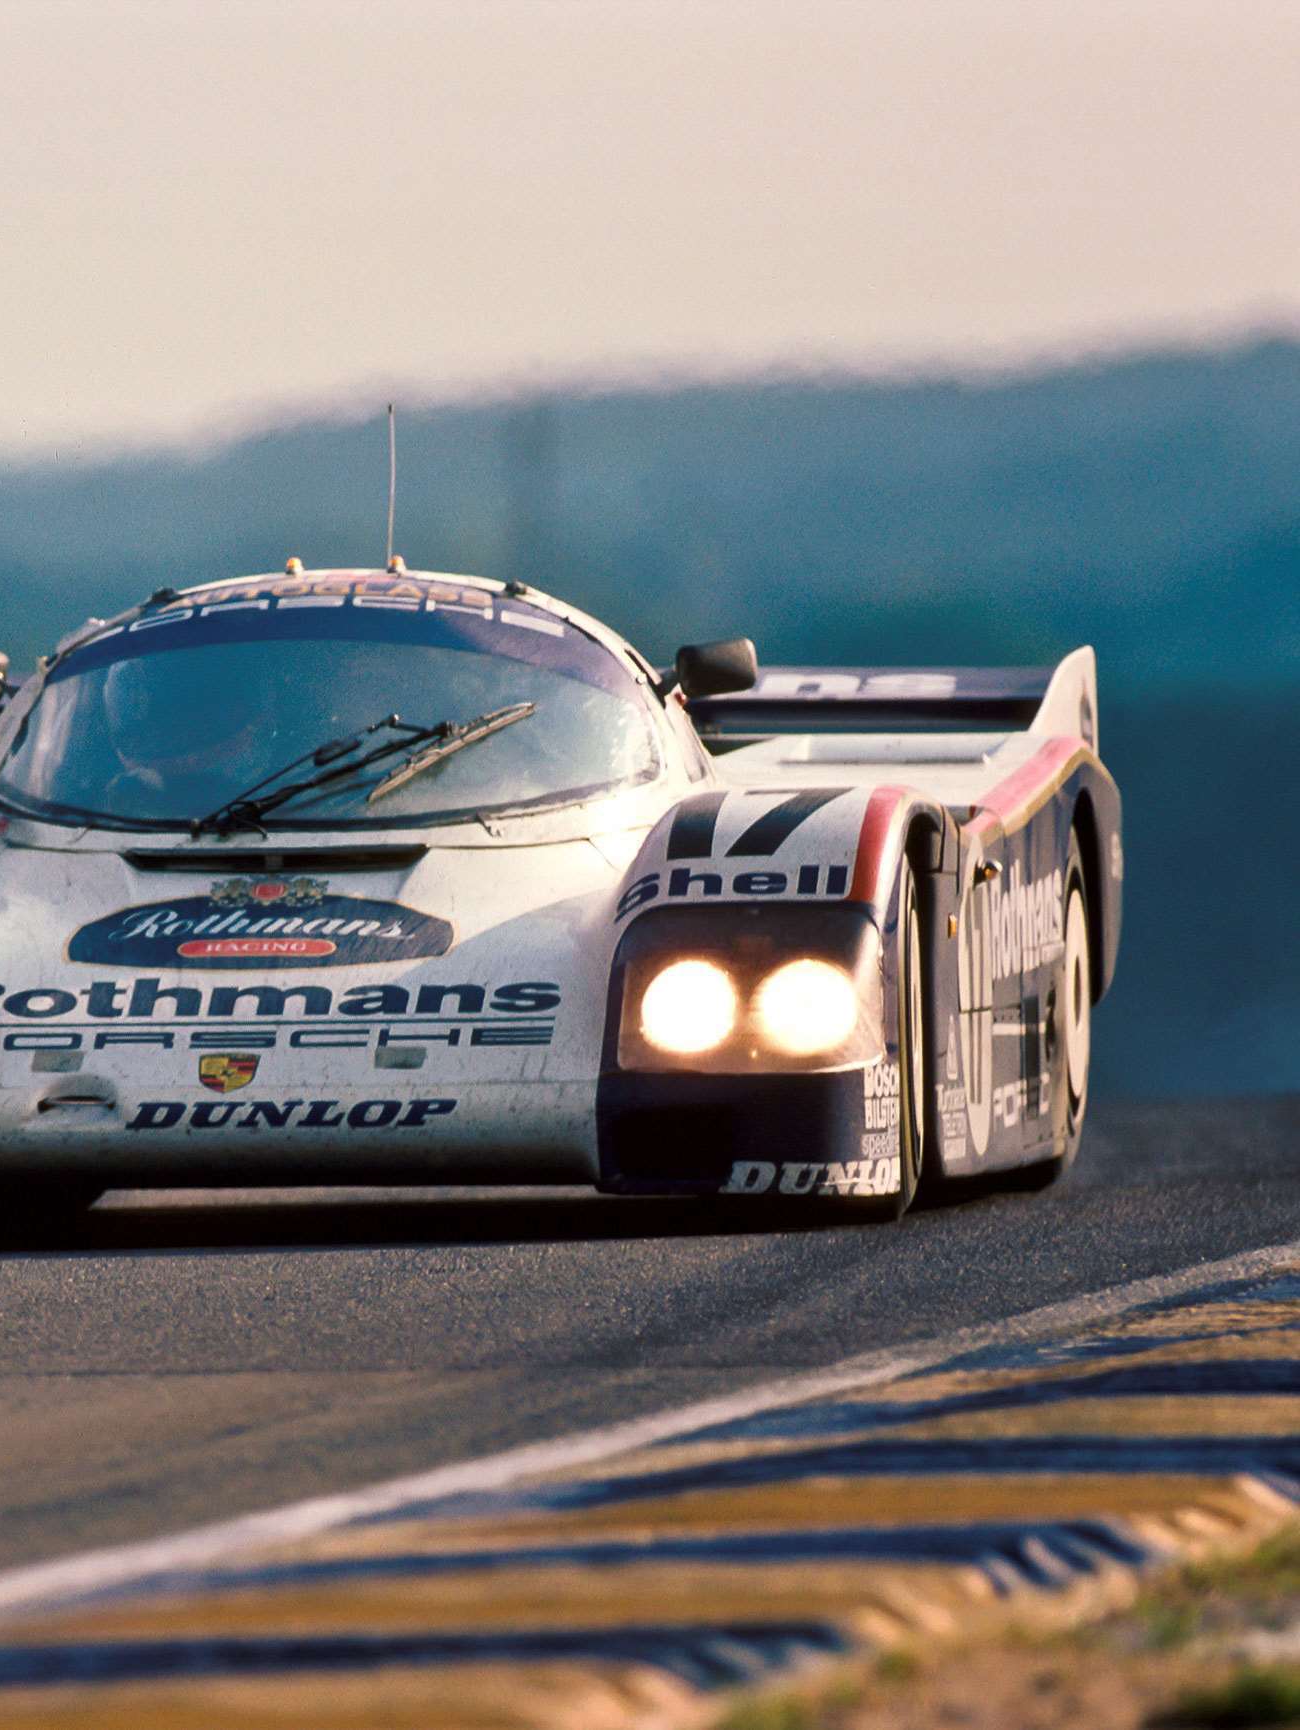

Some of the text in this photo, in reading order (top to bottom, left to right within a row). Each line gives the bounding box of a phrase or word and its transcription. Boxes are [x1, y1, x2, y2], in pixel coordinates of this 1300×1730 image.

[667, 787, 858, 861] 17
[614, 865, 848, 924] Shell
[108, 909, 415, 938] Rothmans
[205, 941, 309, 953] RACING
[125, 1099, 457, 1130] DUNLOP
